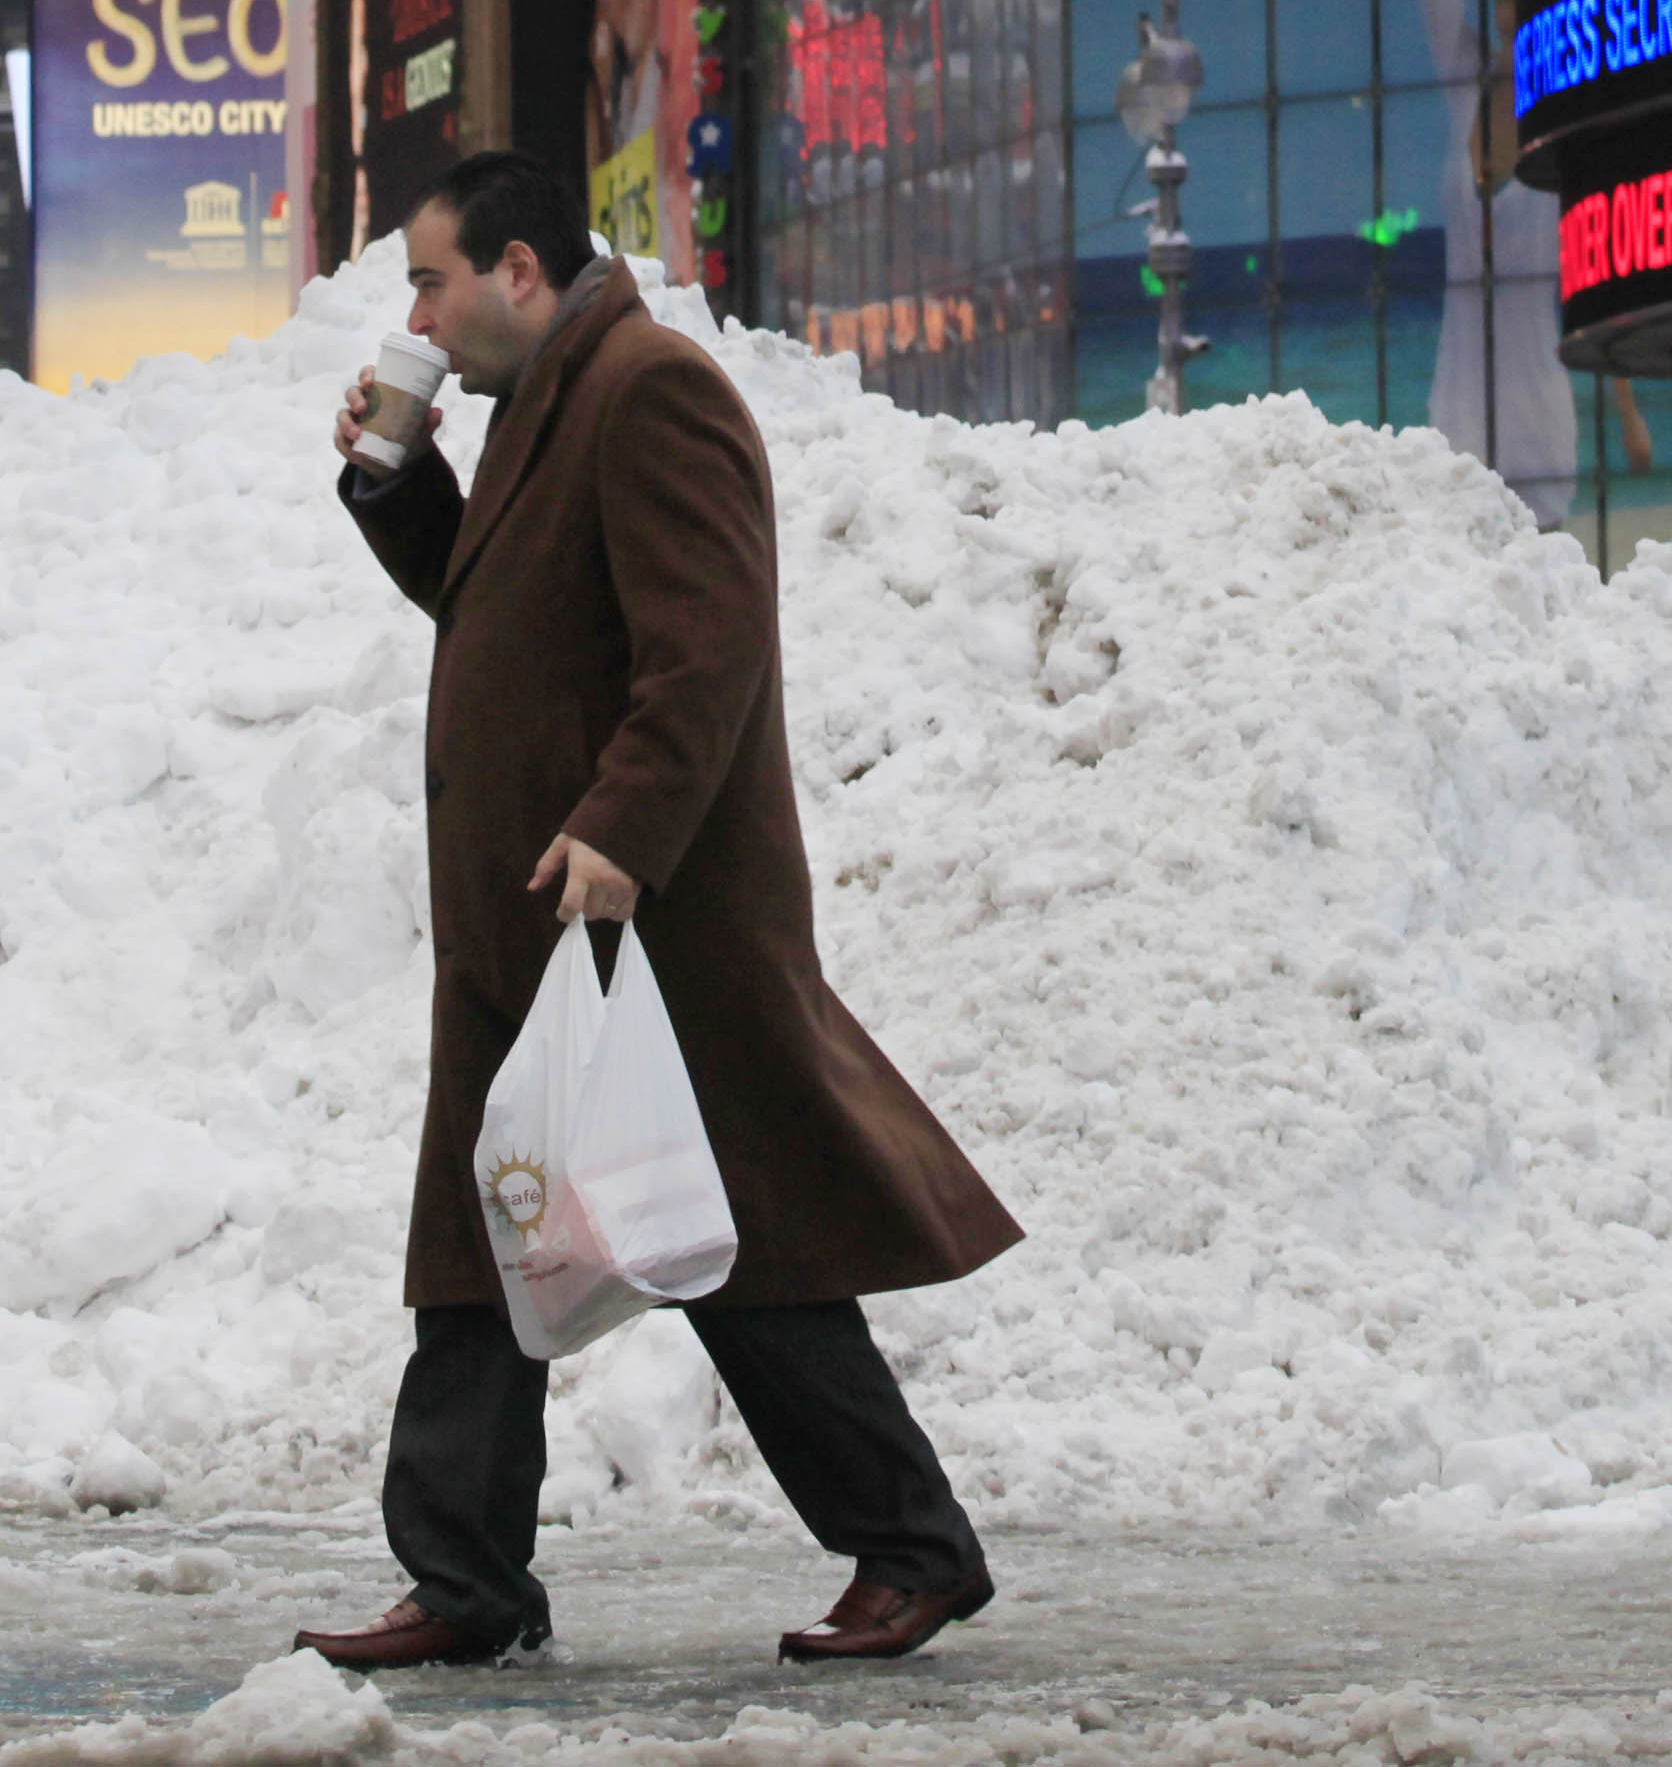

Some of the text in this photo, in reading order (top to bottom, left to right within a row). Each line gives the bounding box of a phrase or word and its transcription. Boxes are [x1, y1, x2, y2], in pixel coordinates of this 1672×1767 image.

[92, 99, 288, 137] UNESCO CITY
[694, 196, 728, 288] US
